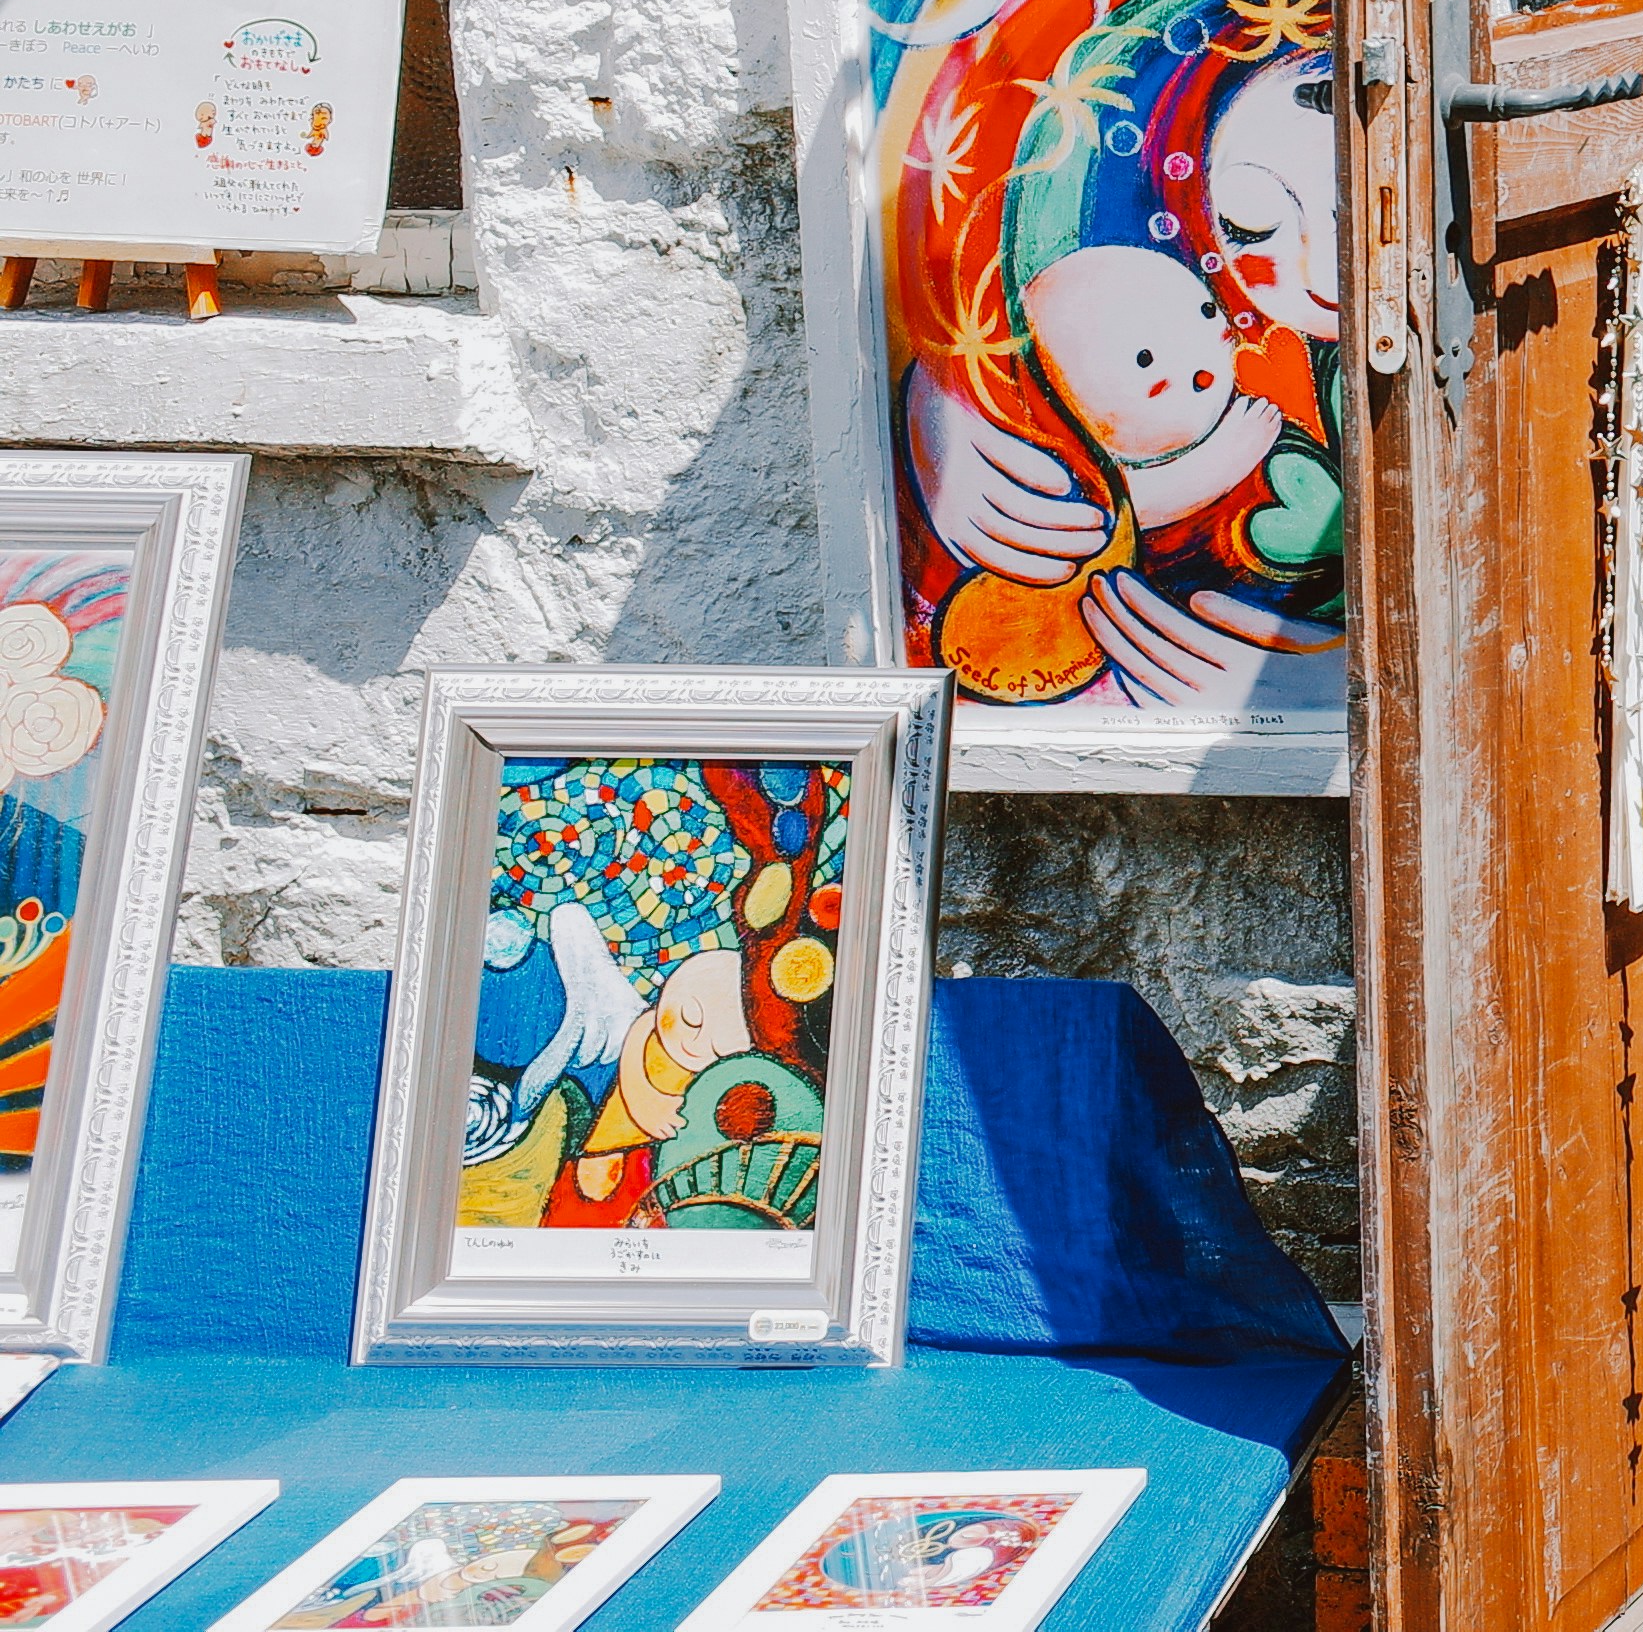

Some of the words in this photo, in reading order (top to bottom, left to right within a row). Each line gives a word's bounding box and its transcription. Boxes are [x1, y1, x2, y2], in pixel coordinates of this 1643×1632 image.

[62, 41, 101, 54] Peace
[240, 54, 299, 72] おもてなし
[948, 646, 1000, 691] Seed
[1007, 675, 1028, 697] of
[1031, 646, 1104, 692] Happiness
